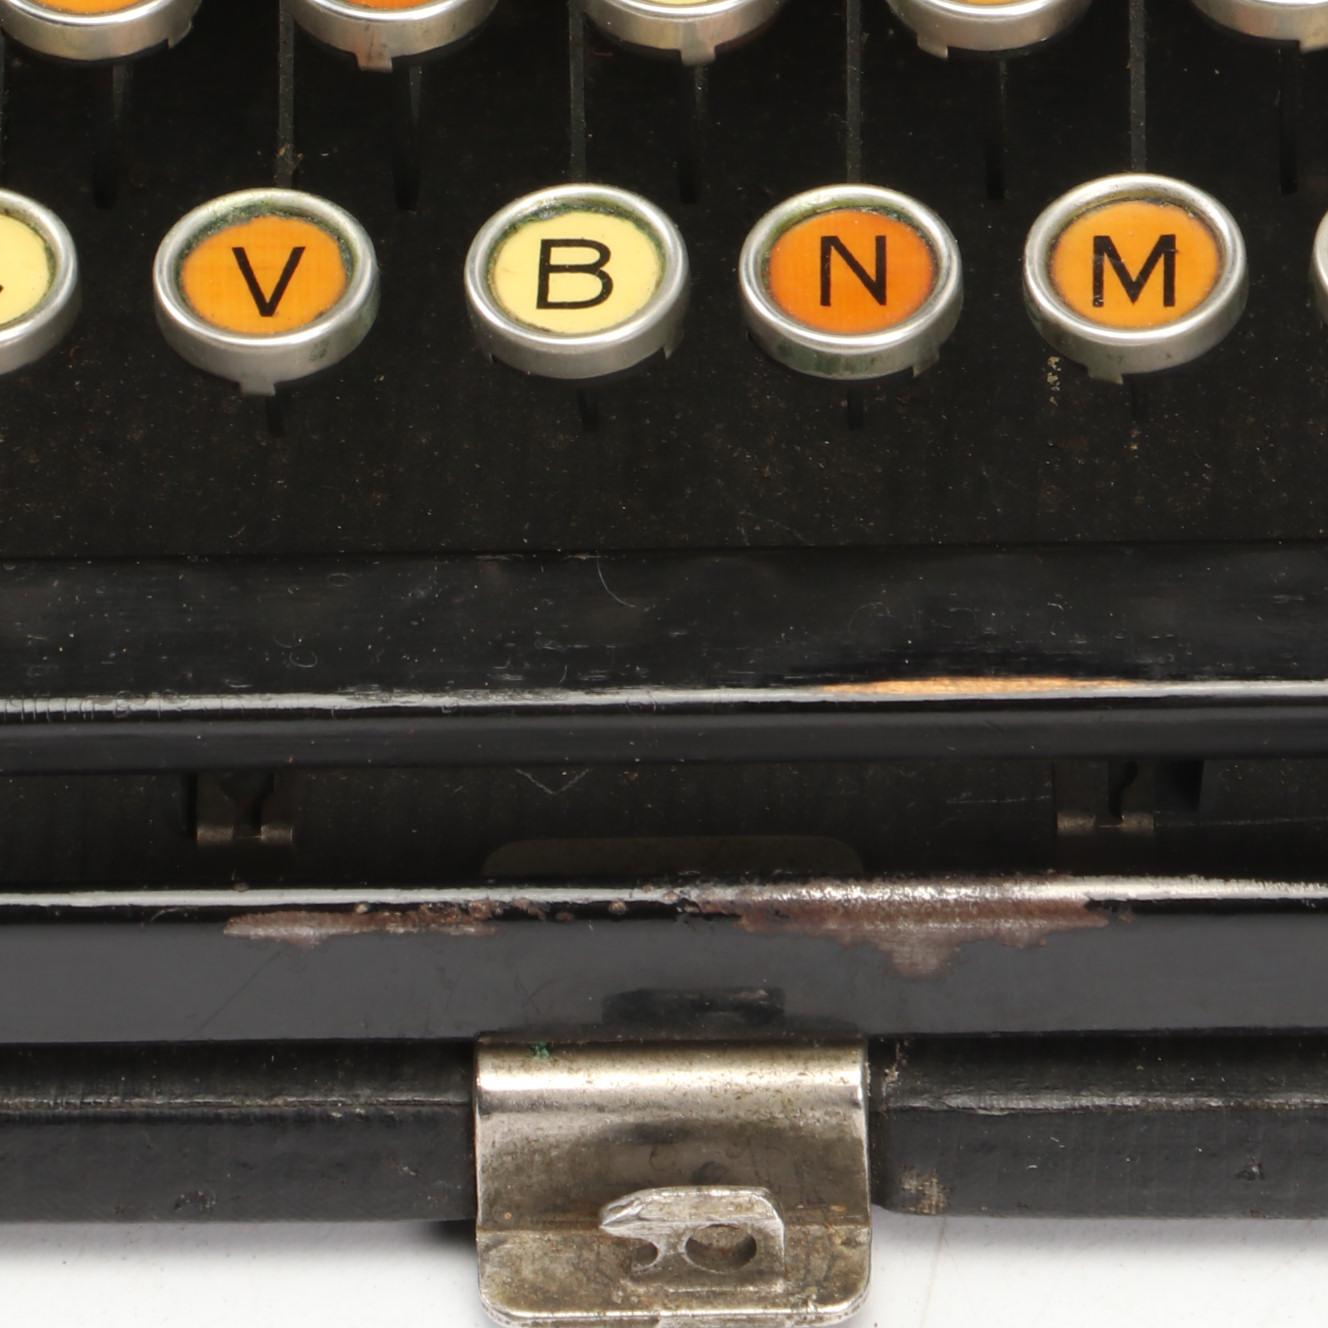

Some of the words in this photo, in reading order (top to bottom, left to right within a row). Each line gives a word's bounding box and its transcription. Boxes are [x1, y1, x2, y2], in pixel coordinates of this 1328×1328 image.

[232, 246, 306, 317] V
[535, 238, 614, 310] B
[819, 235, 887, 307] N
[1091, 234, 1178, 308] M
